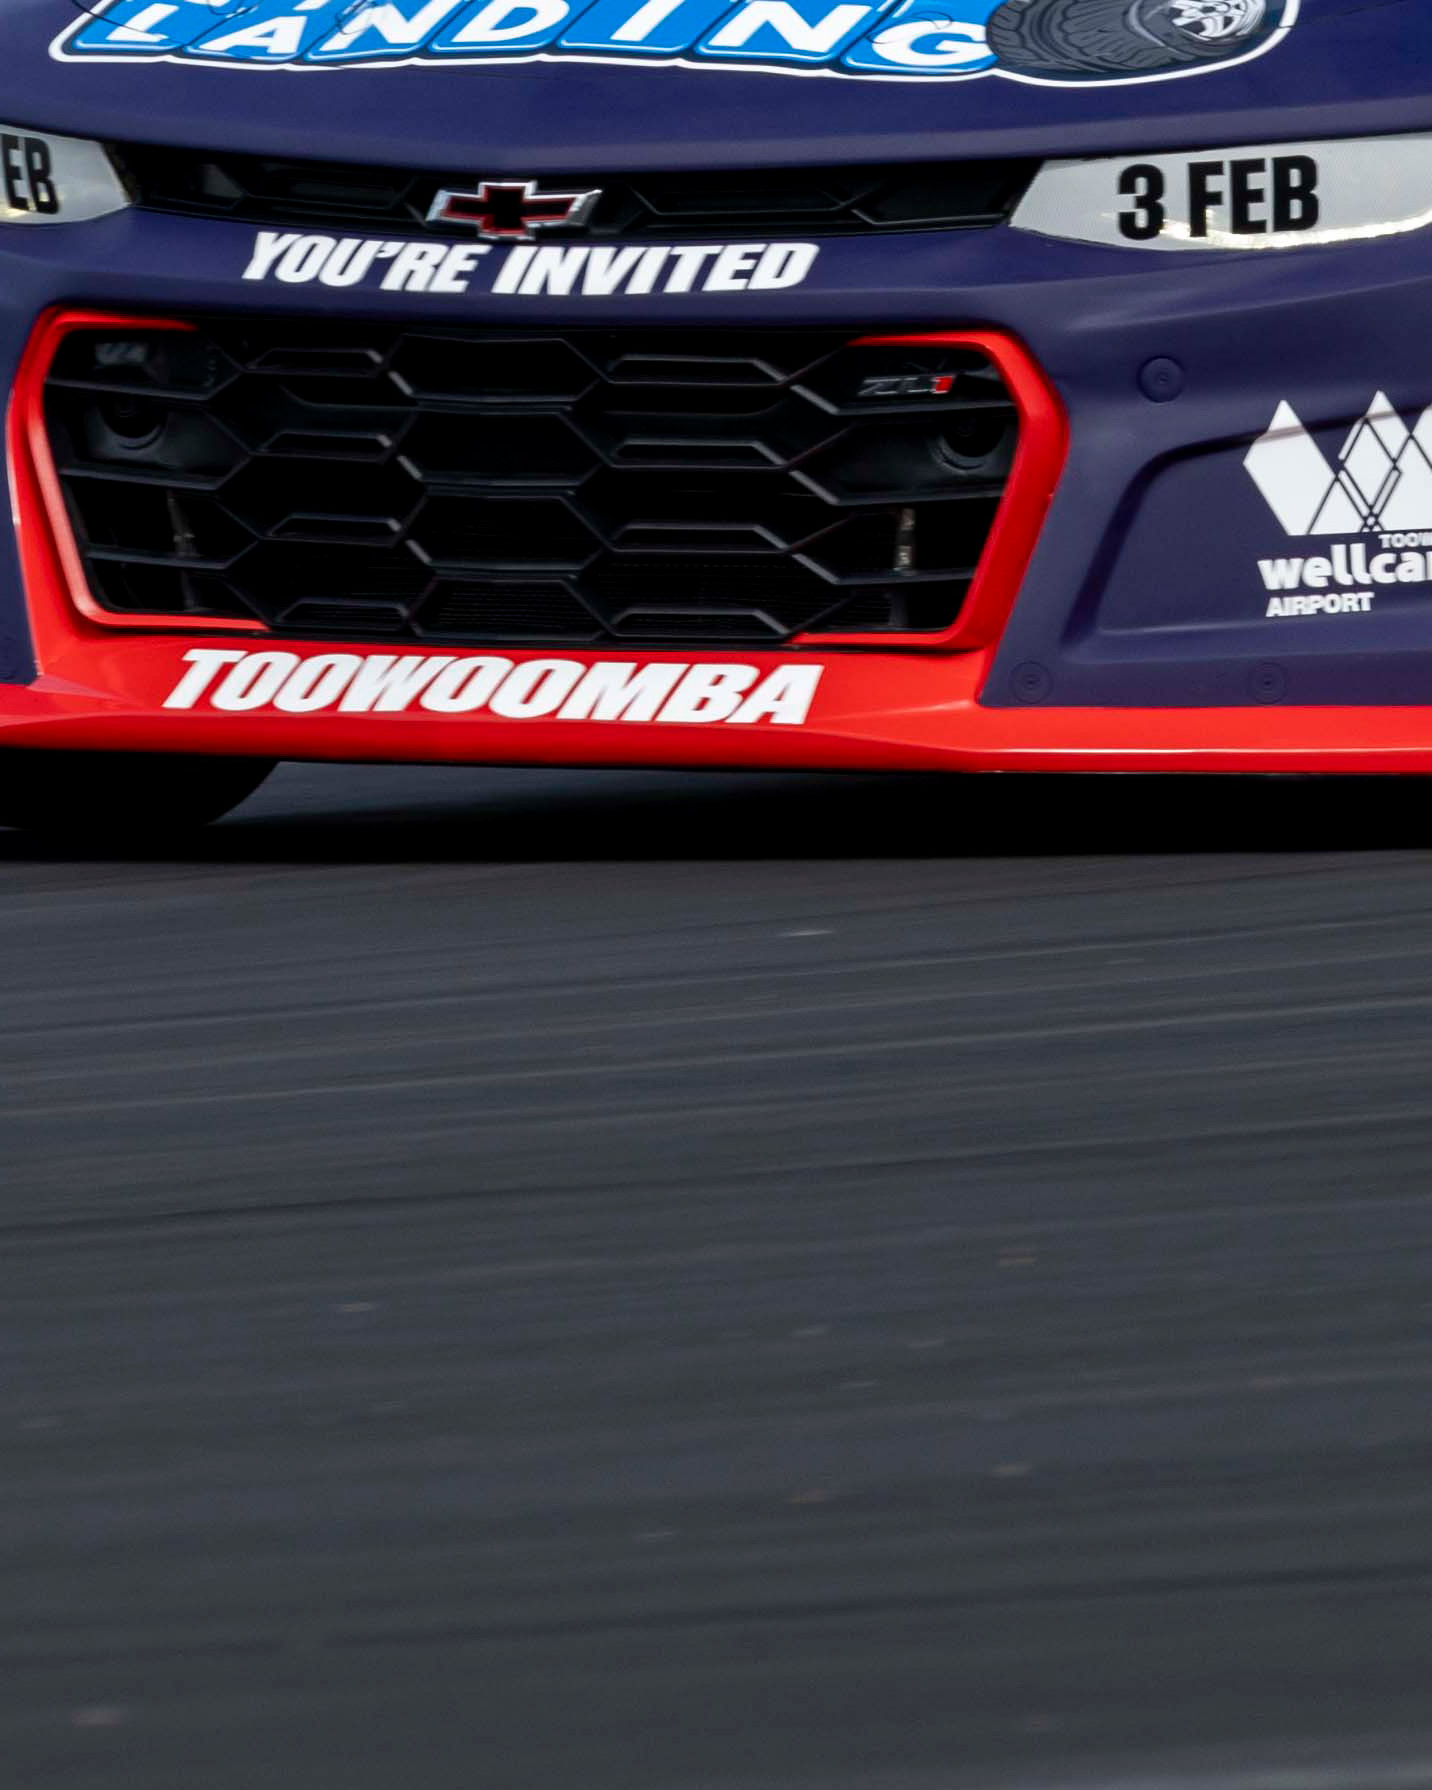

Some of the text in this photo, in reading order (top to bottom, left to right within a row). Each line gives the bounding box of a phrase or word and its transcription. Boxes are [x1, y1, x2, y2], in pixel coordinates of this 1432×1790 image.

[1117, 154, 1320, 240] 3 FEB
[242, 231, 820, 296] YOU'RE INVITED
[1266, 592, 1374, 618] AIRPORT
[163, 648, 826, 726] TOOWOOMBA
